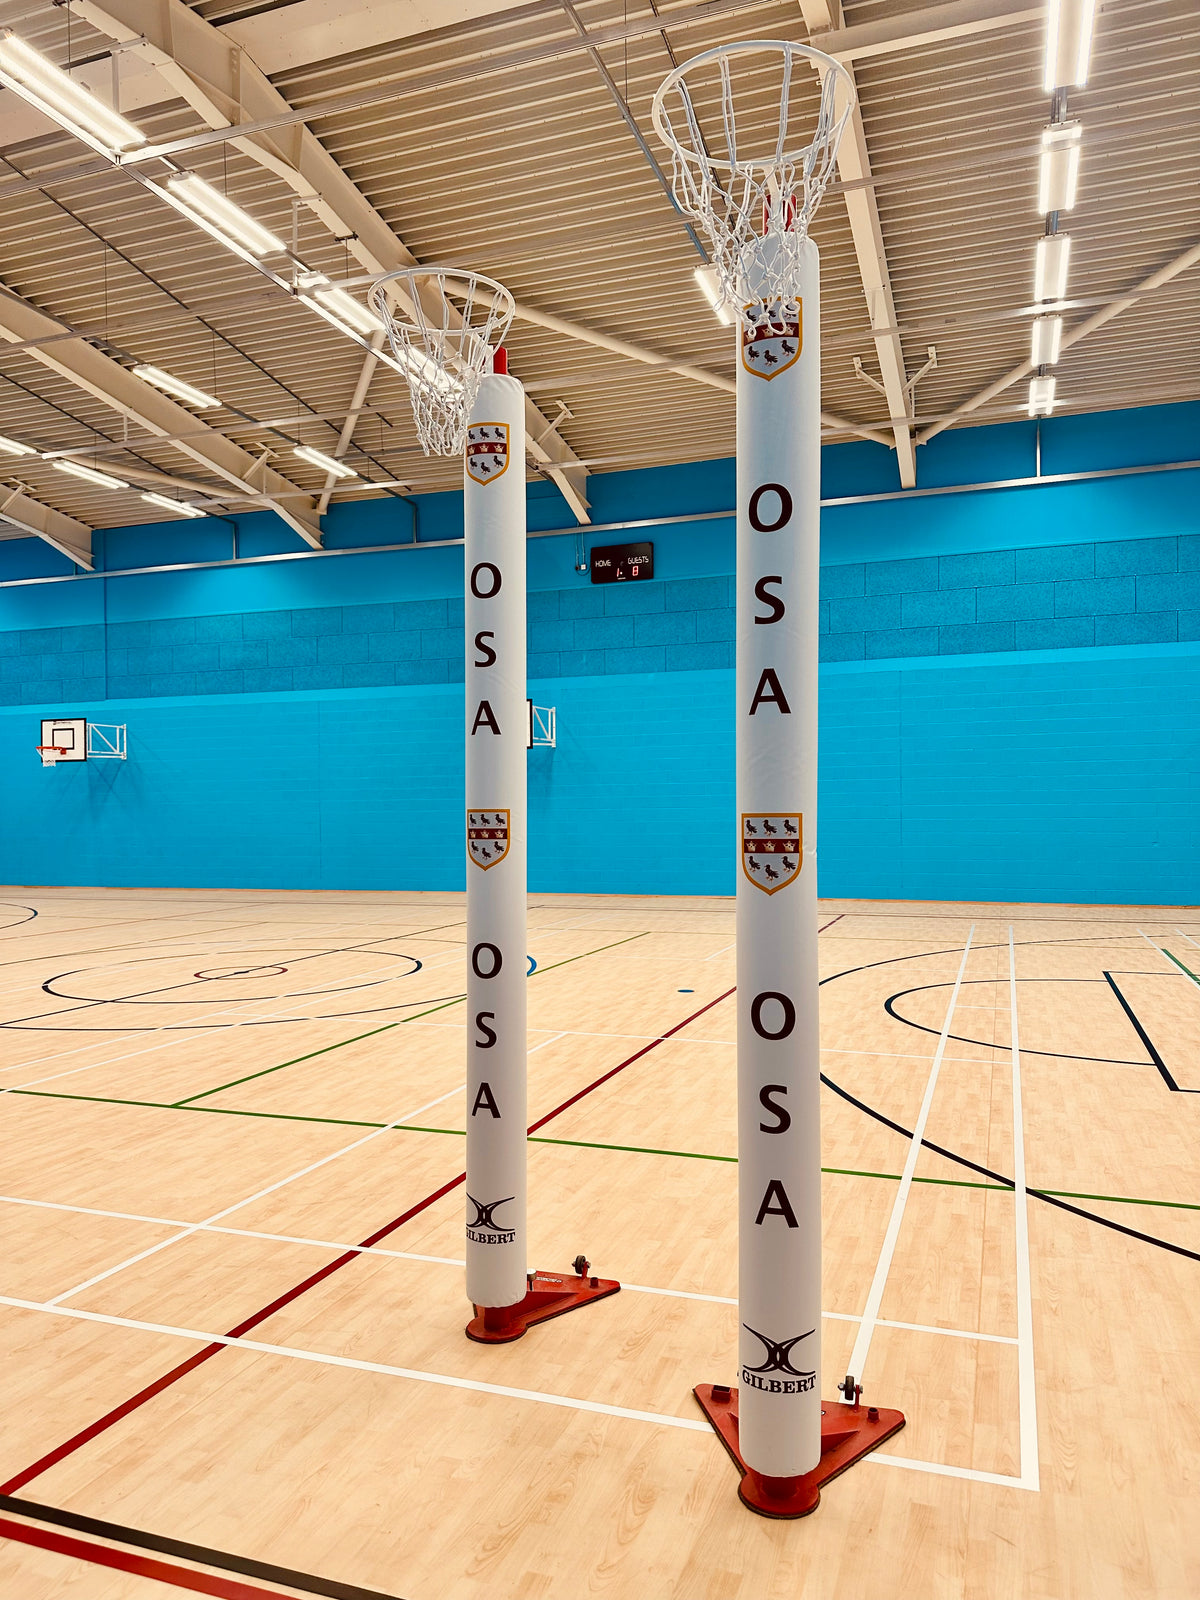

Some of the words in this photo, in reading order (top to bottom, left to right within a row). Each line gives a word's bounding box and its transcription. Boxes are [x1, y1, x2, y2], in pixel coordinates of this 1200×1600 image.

[627, 556, 649, 565] GUESTS
[748, 482, 793, 716] OSA
[470, 562, 502, 736] OSA
[471, 942, 503, 1119] OSA
[750, 991, 800, 1229] OSA
[742, 1369, 816, 1394] GILBERT
